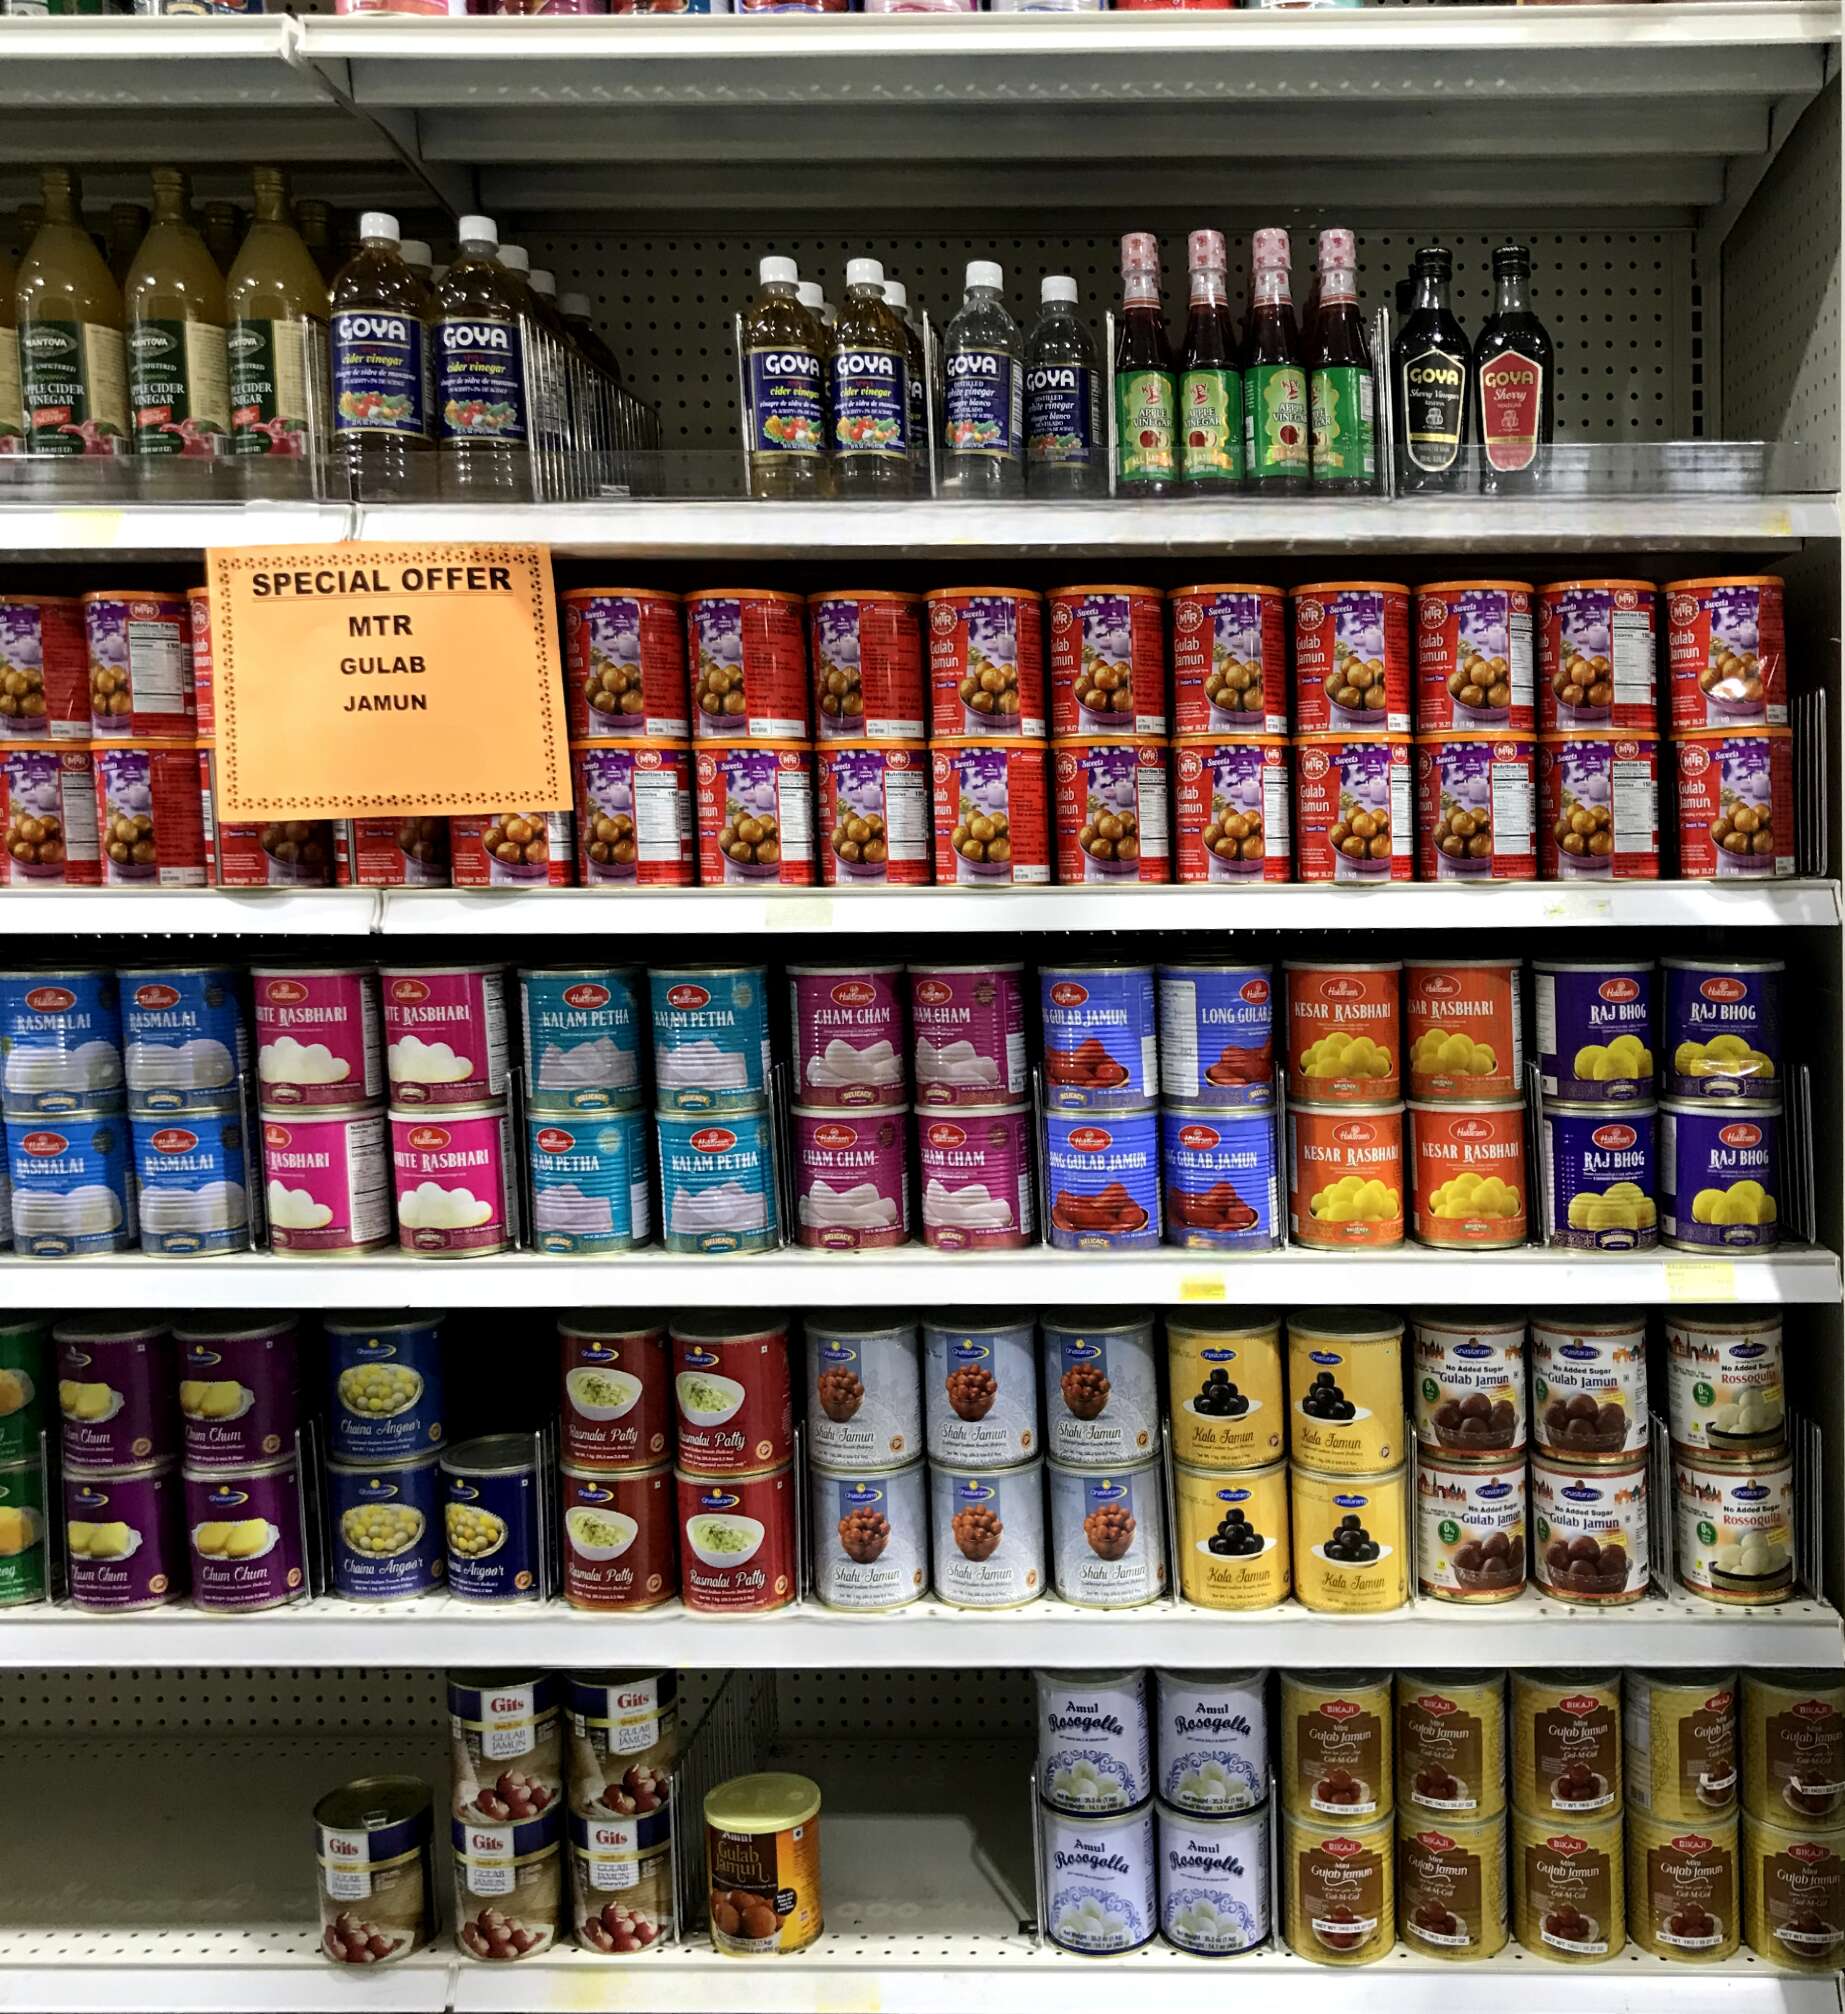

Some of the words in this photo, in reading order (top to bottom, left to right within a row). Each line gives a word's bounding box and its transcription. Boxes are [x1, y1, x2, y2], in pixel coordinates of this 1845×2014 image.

[340, 318, 407, 342] GOYA
[443, 326, 508, 349] GOYA
[342, 353, 364, 365] cider
[366, 353, 403, 368] vinegar
[447, 362, 468, 373] cider
[469, 362, 506, 374] vinegar
[766, 354, 820, 376] GOYA
[837, 355, 893, 376] GOYA
[947, 356, 997, 376] GOYA
[1027, 369, 1074, 391] GOYA
[1410, 368, 1459, 385] GOYA
[1485, 371, 1534, 387] GOYA
[244, 383, 272, 392] CIDER
[840, 387, 859, 397] cider
[861, 386, 891, 398] vinegar
[1409, 388, 1433, 398] Sherry
[1435, 390, 1459, 401] Vinegar
[1493, 388, 1527, 401] Sherry
[969, 398, 991, 407] blanco
[1045, 401, 1074, 411] vinegar
[1138, 408, 1167, 418] APPLE
[1189, 407, 1215, 418] APPLE
[1134, 418, 1173, 428] VINEGAR
[1184, 418, 1223, 427] VINEGAR
[252, 569, 390, 597] SPECIAL
[401, 567, 512, 592] OFFER
[961, 610, 986, 619] Sweets
[349, 614, 413, 637] MTR
[1174, 638, 1200, 652] Gulab
[1296, 636, 1321, 650] Gulab
[1419, 635, 1444, 649] Gulab
[1669, 632, 1696, 645] Gulab
[930, 641, 954, 655] Gulab
[1669, 646, 1700, 659] Jamun
[931, 656, 959, 670] Jamun
[1175, 653, 1204, 667] Jamun
[1297, 651, 1325, 665] Jamun
[1419, 650, 1448, 663] Jamun
[340, 655, 427, 676] GULAB
[343, 694, 427, 712] JAMUN
[1177, 788, 1199, 800] Gulab
[1300, 786, 1325, 799] Gulab
[1678, 782, 1706, 795] Gulab
[1301, 800, 1329, 813] Jamun
[1679, 796, 1711, 809] Jamun
[279, 1006, 348, 1026] RASBHARI
[403, 1004, 470, 1026] RASBHARI
[817, 1008, 852, 1025] CHAM
[857, 1007, 890, 1023] CHAM
[934, 1008, 971, 1024] CHAM
[1050, 1008, 1081, 1025] GULAB
[1083, 1008, 1128, 1027] JAMUN
[1202, 1008, 1234, 1024] LONG
[1295, 1002, 1329, 1018] KESAR
[1334, 1003, 1391, 1023] RASBHARI
[1430, 1000, 1494, 1019] RASBHARI
[1589, 1004, 1616, 1025] RAJ
[1619, 1003, 1646, 1019] BHOG
[1689, 1003, 1716, 1022] RAJ
[1721, 1004, 1756, 1020] BHOG
[17, 1014, 91, 1034] RASMALAI
[129, 1011, 196, 1032] RASMALAI
[543, 1011, 589, 1030] KALAM
[591, 1009, 630, 1026] PETHA
[691, 1011, 735, 1026] PETHA
[803, 1150, 833, 1166] CHAM
[837, 1150, 876, 1167] CHAM
[948, 1151, 985, 1166] CHAM
[1177, 1152, 1213, 1168] GULAB
[1215, 1151, 1257, 1170] JAMUN
[1304, 1145, 1340, 1161] KESAR
[1347, 1146, 1399, 1166] RASBHARI
[1422, 1142, 1458, 1159] KESAR
[1464, 1142, 1519, 1163] RASBHARI
[1709, 1150, 1736, 1170] RAJ
[1739, 1149, 1769, 1166] BHOG
[271, 1152, 330, 1171] RASBHARI
[556, 1155, 600, 1171] PETHA
[672, 1154, 715, 1173] KALAM
[717, 1152, 758, 1171] PETHA
[1582, 1152, 1610, 1172] RAJ
[1614, 1150, 1645, 1168] BHOG
[1446, 1364, 1455, 1372] No
[1457, 1365, 1482, 1373] Added
[1484, 1365, 1504, 1374] Sugar
[1552, 1364, 1562, 1372] No
[1564, 1366, 1588, 1375] Added
[1589, 1367, 1612, 1376] Sugar
[1734, 1363, 1757, 1372] Added
[1759, 1361, 1775, 1371] Sugar
[1440, 1371, 1472, 1385] Gulab
[1476, 1374, 1509, 1388] Jamun
[1548, 1373, 1578, 1386] Gulab
[1580, 1377, 1618, 1388] Jamun
[82, 1427, 111, 1444] Chum
[209, 1426, 242, 1443] Chum
[610, 1428, 639, 1444] Patty
[714, 1431, 746, 1450] Patty
[837, 1426, 875, 1443] Jamun
[942, 1424, 968, 1440] Shahi
[971, 1426, 1007, 1441] Jamun
[1192, 1427, 1216, 1443] Kala
[1220, 1430, 1255, 1443] Jamun
[1302, 1428, 1322, 1446] Kala
[1324, 1433, 1362, 1450] Jamun
[1566, 1508, 1589, 1516] Added
[1591, 1509, 1613, 1518] Sugar
[1761, 1503, 1780, 1512] Sugar
[1550, 1513, 1580, 1527] Gulab
[1583, 1517, 1619, 1530] Jamun
[1723, 1512, 1781, 1527] Rossogulla
[98, 1566, 128, 1582] Chum
[202, 1566, 231, 1581] Chum
[234, 1566, 269, 1581] Chum
[1207, 1567, 1232, 1582] Kala
[1236, 1567, 1271, 1582] Jamun
[1322, 1572, 1347, 1589] Kala
[1350, 1575, 1386, 1589] Jamun
[490, 1698, 524, 1713] Gits
[617, 1692, 649, 1709] Gits
[1066, 1701, 1099, 1714] Amul
[1195, 1702, 1229, 1715] Amul
[1423, 1698, 1450, 1710] BIKAJI
[1566, 1701, 1593, 1709] BIKAJI
[1326, 1705, 1354, 1714] BIKAJI
[1049, 1713, 1125, 1737] Rosogolla
[1174, 1715, 1251, 1737] Rosogolla
[472, 1834, 504, 1850] Gits
[595, 1829, 628, 1845] Gits
[1553, 1840, 1581, 1849] BIKAJI
[329, 1838, 359, 1856] Gits
[718, 1841, 759, 1862] Gulab
[1074, 1839, 1105, 1853] Amul
[1187, 1840, 1220, 1854] Amul
[1328, 1842, 1355, 1850] BIKAJI
[1055, 1850, 1131, 1874] Rosogolla
[1169, 1850, 1245, 1877] Rosogolla
